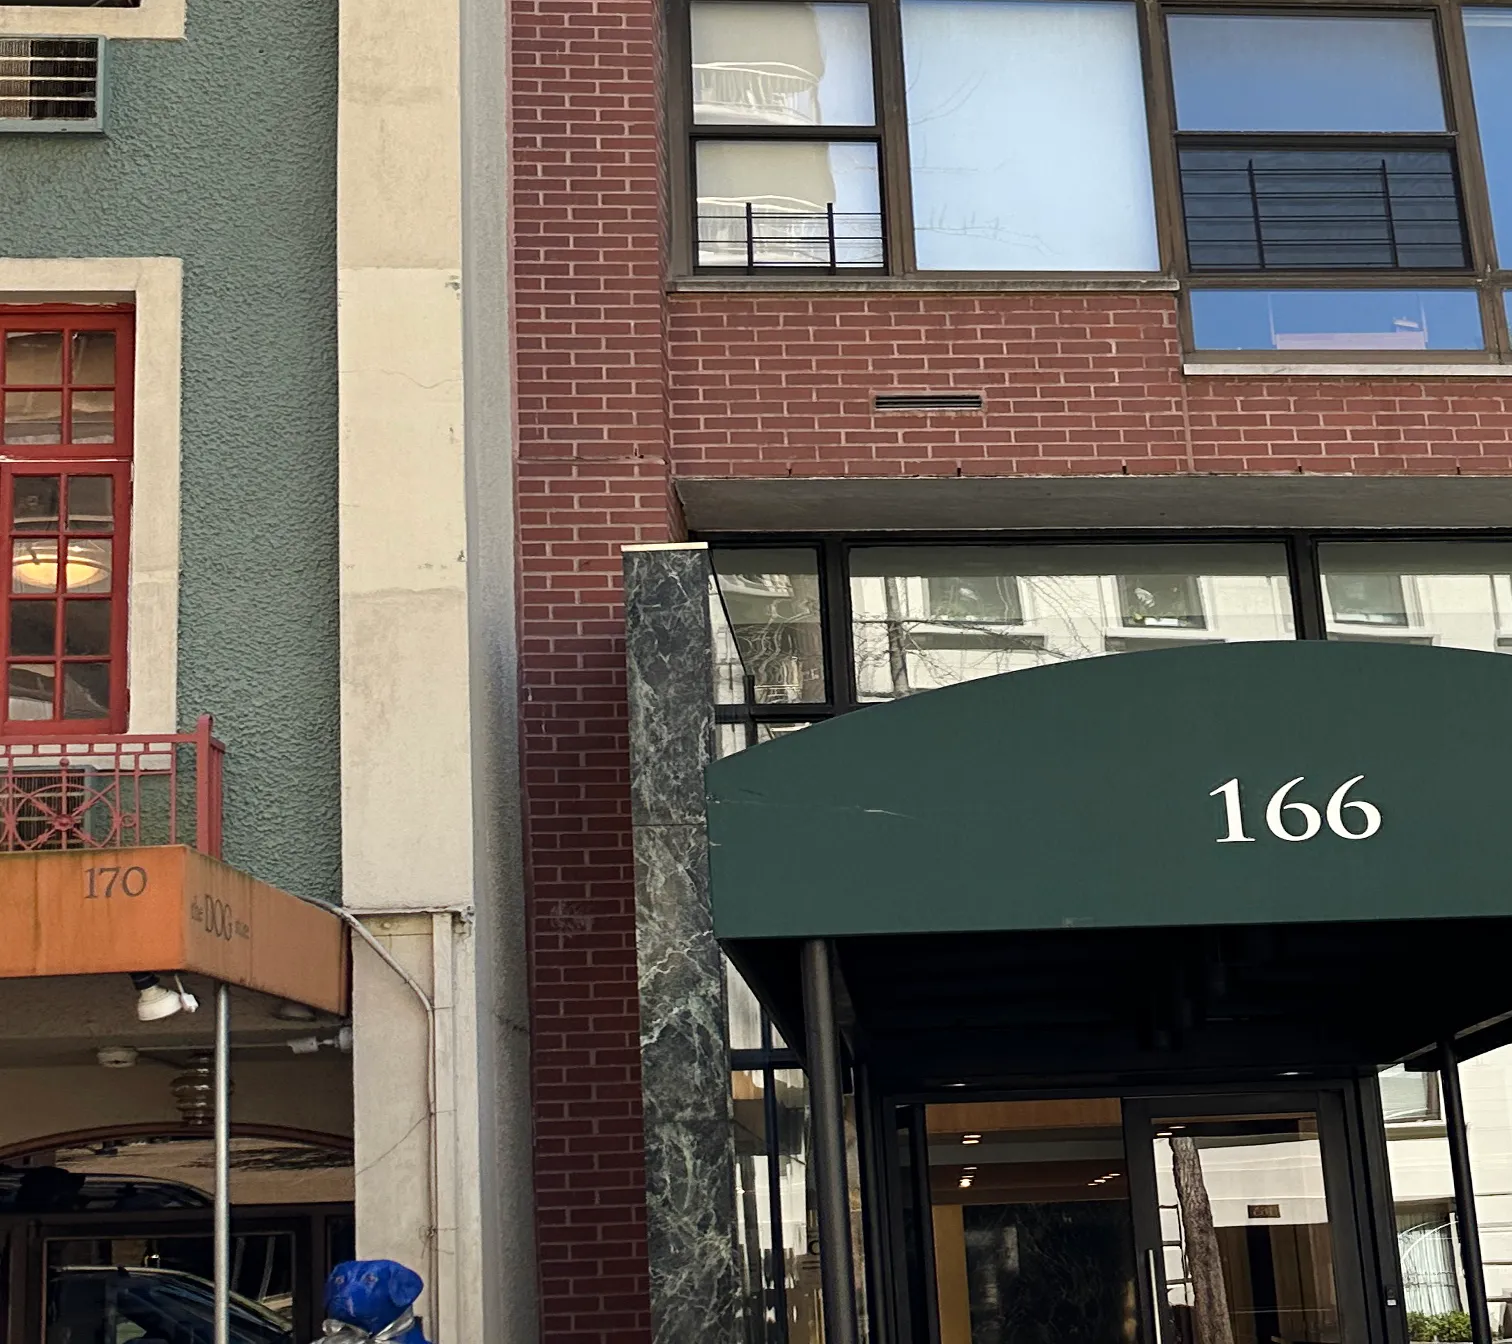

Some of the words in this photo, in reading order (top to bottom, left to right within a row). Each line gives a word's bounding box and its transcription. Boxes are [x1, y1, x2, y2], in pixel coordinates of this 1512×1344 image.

[1208, 774, 1382, 843] 166
[84, 865, 148, 900] 170
[204, 893, 233, 942] DOG
